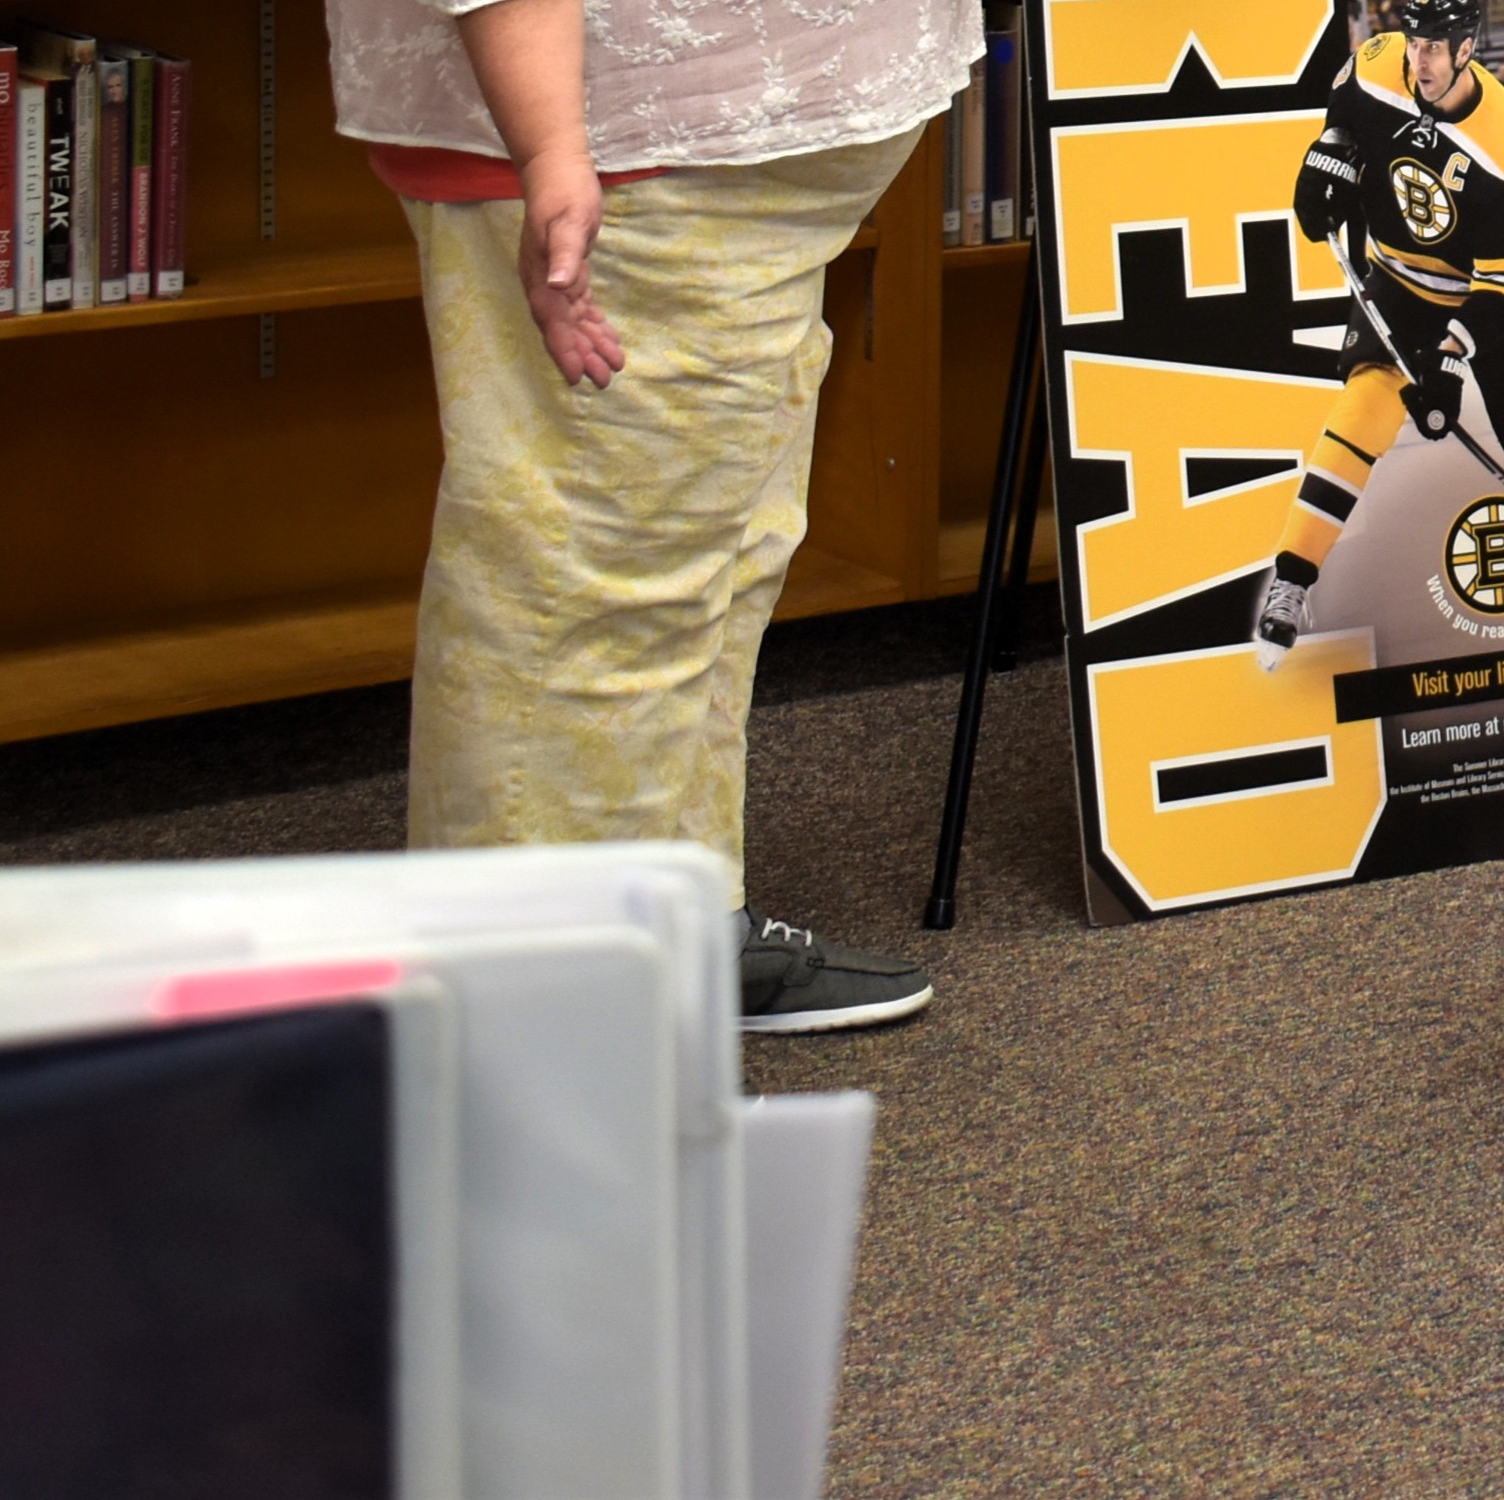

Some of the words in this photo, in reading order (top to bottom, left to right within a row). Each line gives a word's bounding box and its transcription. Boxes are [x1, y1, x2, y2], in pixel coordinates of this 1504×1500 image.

[171, 75, 181, 107] ANNE
[170, 110, 181, 147] FRANK
[26, 103, 42, 202] beautiful
[1442, 152, 1471, 191] C
[49, 136, 70, 230] TWEAK
[138, 172, 148, 225] BRANDON
[1404, 171, 1436, 227] B
[24, 212, 41, 247] boy
[137, 237, 147, 267] WOLF
[1426, 574, 1454, 619] When
[1454, 613, 1478, 636] you
[1412, 670, 1448, 697] Visit
[1455, 665, 1491, 693] your
[1402, 724, 1442, 749] Learn
[1446, 722, 1481, 741] more
[1485, 718, 1500, 736] at
